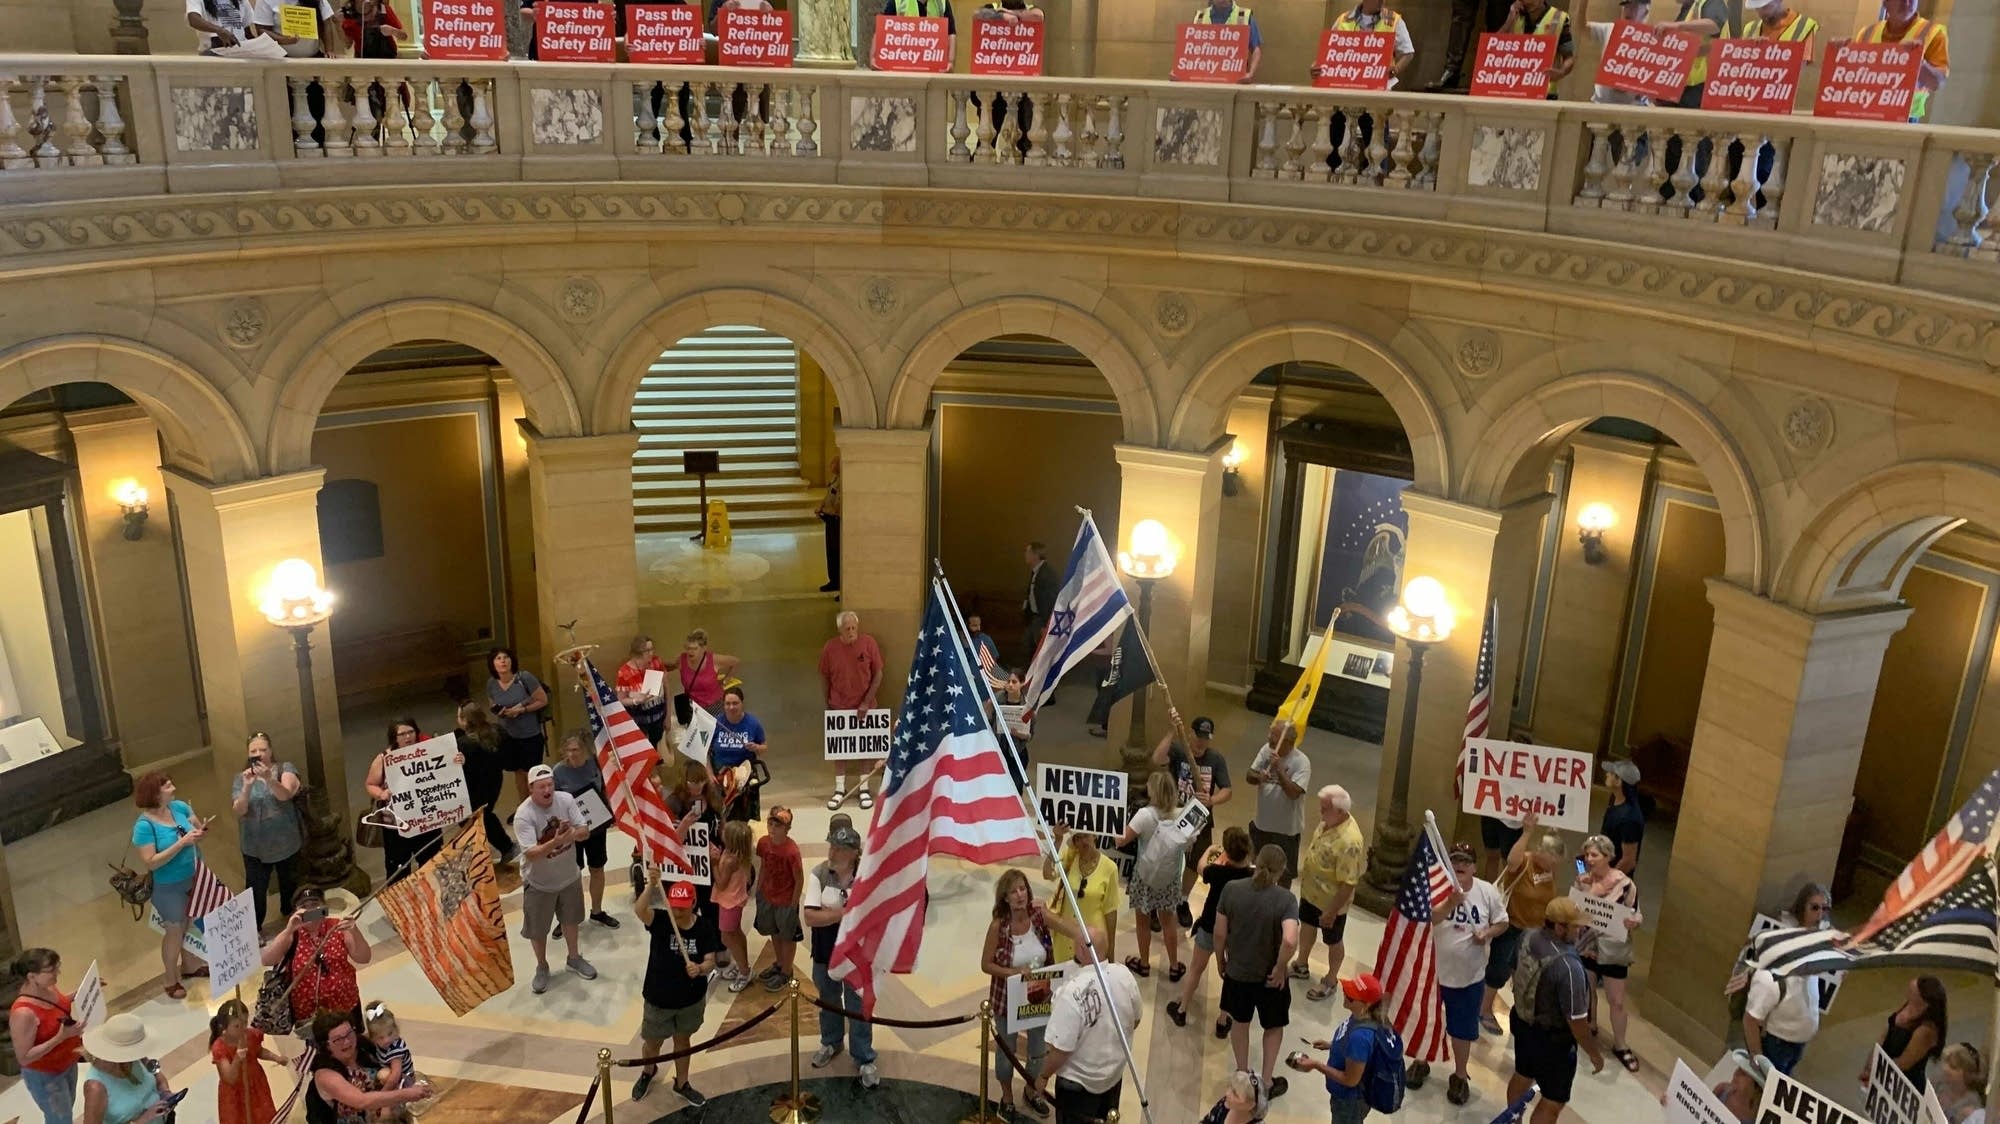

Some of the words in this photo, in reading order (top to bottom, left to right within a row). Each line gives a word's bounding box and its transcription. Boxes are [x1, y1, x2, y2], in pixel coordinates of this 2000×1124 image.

[432, 2, 468, 15] Pass
[472, 2, 494, 16] the
[545, 6, 578, 19] Pass
[583, 7, 605, 20] the
[635, 9, 668, 21] Pass
[672, 9, 693, 21] the
[434, 18, 495, 34] Refinery
[727, 13, 759, 26] Pass
[762, 13, 783, 27] the
[884, 19, 915, 32] Pass
[919, 20, 939, 32] the
[547, 22, 605, 38] Refinery
[637, 24, 693, 39] Refinery
[728, 28, 783, 44] Refinery
[981, 23, 1011, 36] Pass
[1014, 24, 1035, 36] the
[1185, 27, 1216, 40] Pass
[1220, 27, 1240, 41] the
[430, 34, 476, 50] Safety
[479, 35, 502, 48] Bill
[542, 37, 586, 53] Safety
[589, 38, 611, 51] Bill
[633, 40, 676, 54] Safety
[679, 38, 700, 51] Bill
[885, 34, 939, 49] Refinery
[980, 38, 1034, 54] Refinery
[1328, 34, 1360, 47] Pass
[1364, 34, 1385, 48] the
[1487, 37, 1520, 51] Pass
[1524, 38, 1546, 53] the
[1621, 25, 1658, 45] Pass
[1662, 34, 1689, 51] the
[723, 43, 764, 59] Safety
[767, 44, 789, 57] Bill
[879, 48, 919, 63] Safety
[924, 49, 944, 62] Bill
[1184, 42, 1238, 59] Refinery
[1326, 49, 1382, 66] Refinery
[1616, 42, 1683, 71] Refinery
[1721, 43, 1761, 60] Pass
[1765, 45, 1792, 61] the
[1836, 47, 1877, 64] Pass
[1881, 48, 1910, 65] the
[975, 53, 1015, 68] Safety
[1018, 53, 1039, 66] Bill
[1178, 57, 1218, 73] Safety
[1222, 58, 1243, 72] Bill
[1484, 53, 1543, 72] Refinery
[1320, 65, 1361, 81] Safety
[1363, 66, 1386, 79] Bill
[1476, 70, 1520, 88] Safety
[1522, 70, 1546, 86] Bill
[1603, 58, 1653, 82] Safety
[1655, 69, 1684, 88] Bill
[1717, 62, 1788, 84] Refinery
[1832, 67, 1906, 89] Refinery
[1708, 81, 1761, 102] Safety
[1763, 84, 1792, 100] Bill
[1821, 87, 1876, 109] Safety
[1878, 89, 1909, 106] Bill
[827, 716, 845, 730] NO
[849, 714, 889, 729] DEALS
[827, 736, 856, 754] WITH
[859, 735, 889, 753] DEMS
[400, 755, 447, 777] WALZ
[415, 772, 435, 784] and
[1045, 767, 1120, 800] NEVER
[392, 790, 412, 804] MN
[404, 801, 414, 811] of
[421, 791, 457, 806] Health
[1037, 797, 1125, 835] AGAIN
[671, 887, 689, 898] USA
[1584, 897, 1614, 911] NEVER
[1584, 907, 1613, 920] AGAIN
[1592, 919, 1608, 928] OW
[1680, 1080, 1703, 1105] MORT
[1875, 1053, 1920, 1124] NEVER
[1676, 1092, 1700, 1120] RINOS
[1773, 1078, 1858, 1124] NEV
